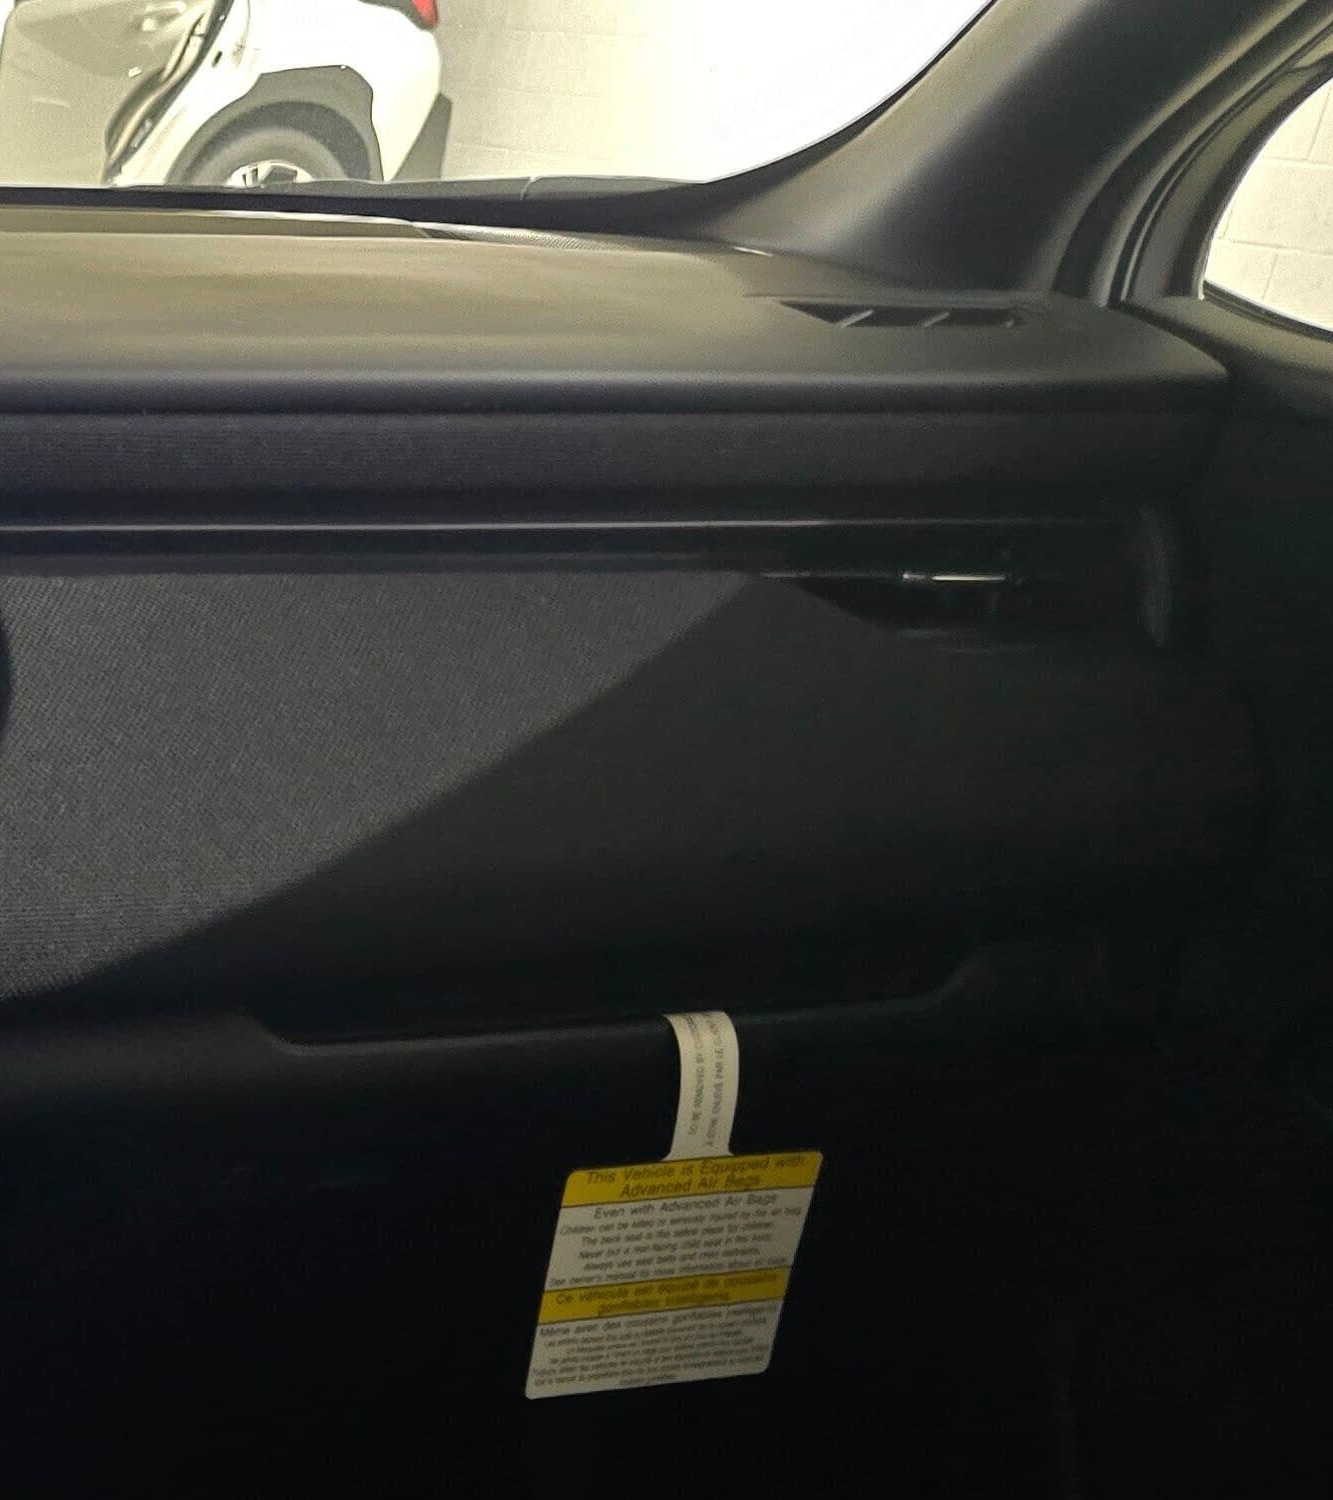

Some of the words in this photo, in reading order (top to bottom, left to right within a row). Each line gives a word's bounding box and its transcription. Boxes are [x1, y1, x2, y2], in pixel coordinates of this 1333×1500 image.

[587, 1171, 616, 1185] This
[624, 1165, 675, 1181] Vehicle
[682, 1165, 694, 1176] is
[700, 1156, 771, 1174] Equipped
[620, 1180, 693, 1199] Advanced
[697, 1176, 718, 1190] Air
[594, 1207, 626, 1219] Even
[630, 1203, 655, 1215] with
[660, 1198, 721, 1213] Advanced
[725, 1195, 743, 1207] Air
[747, 1193, 778, 1206] Bags
